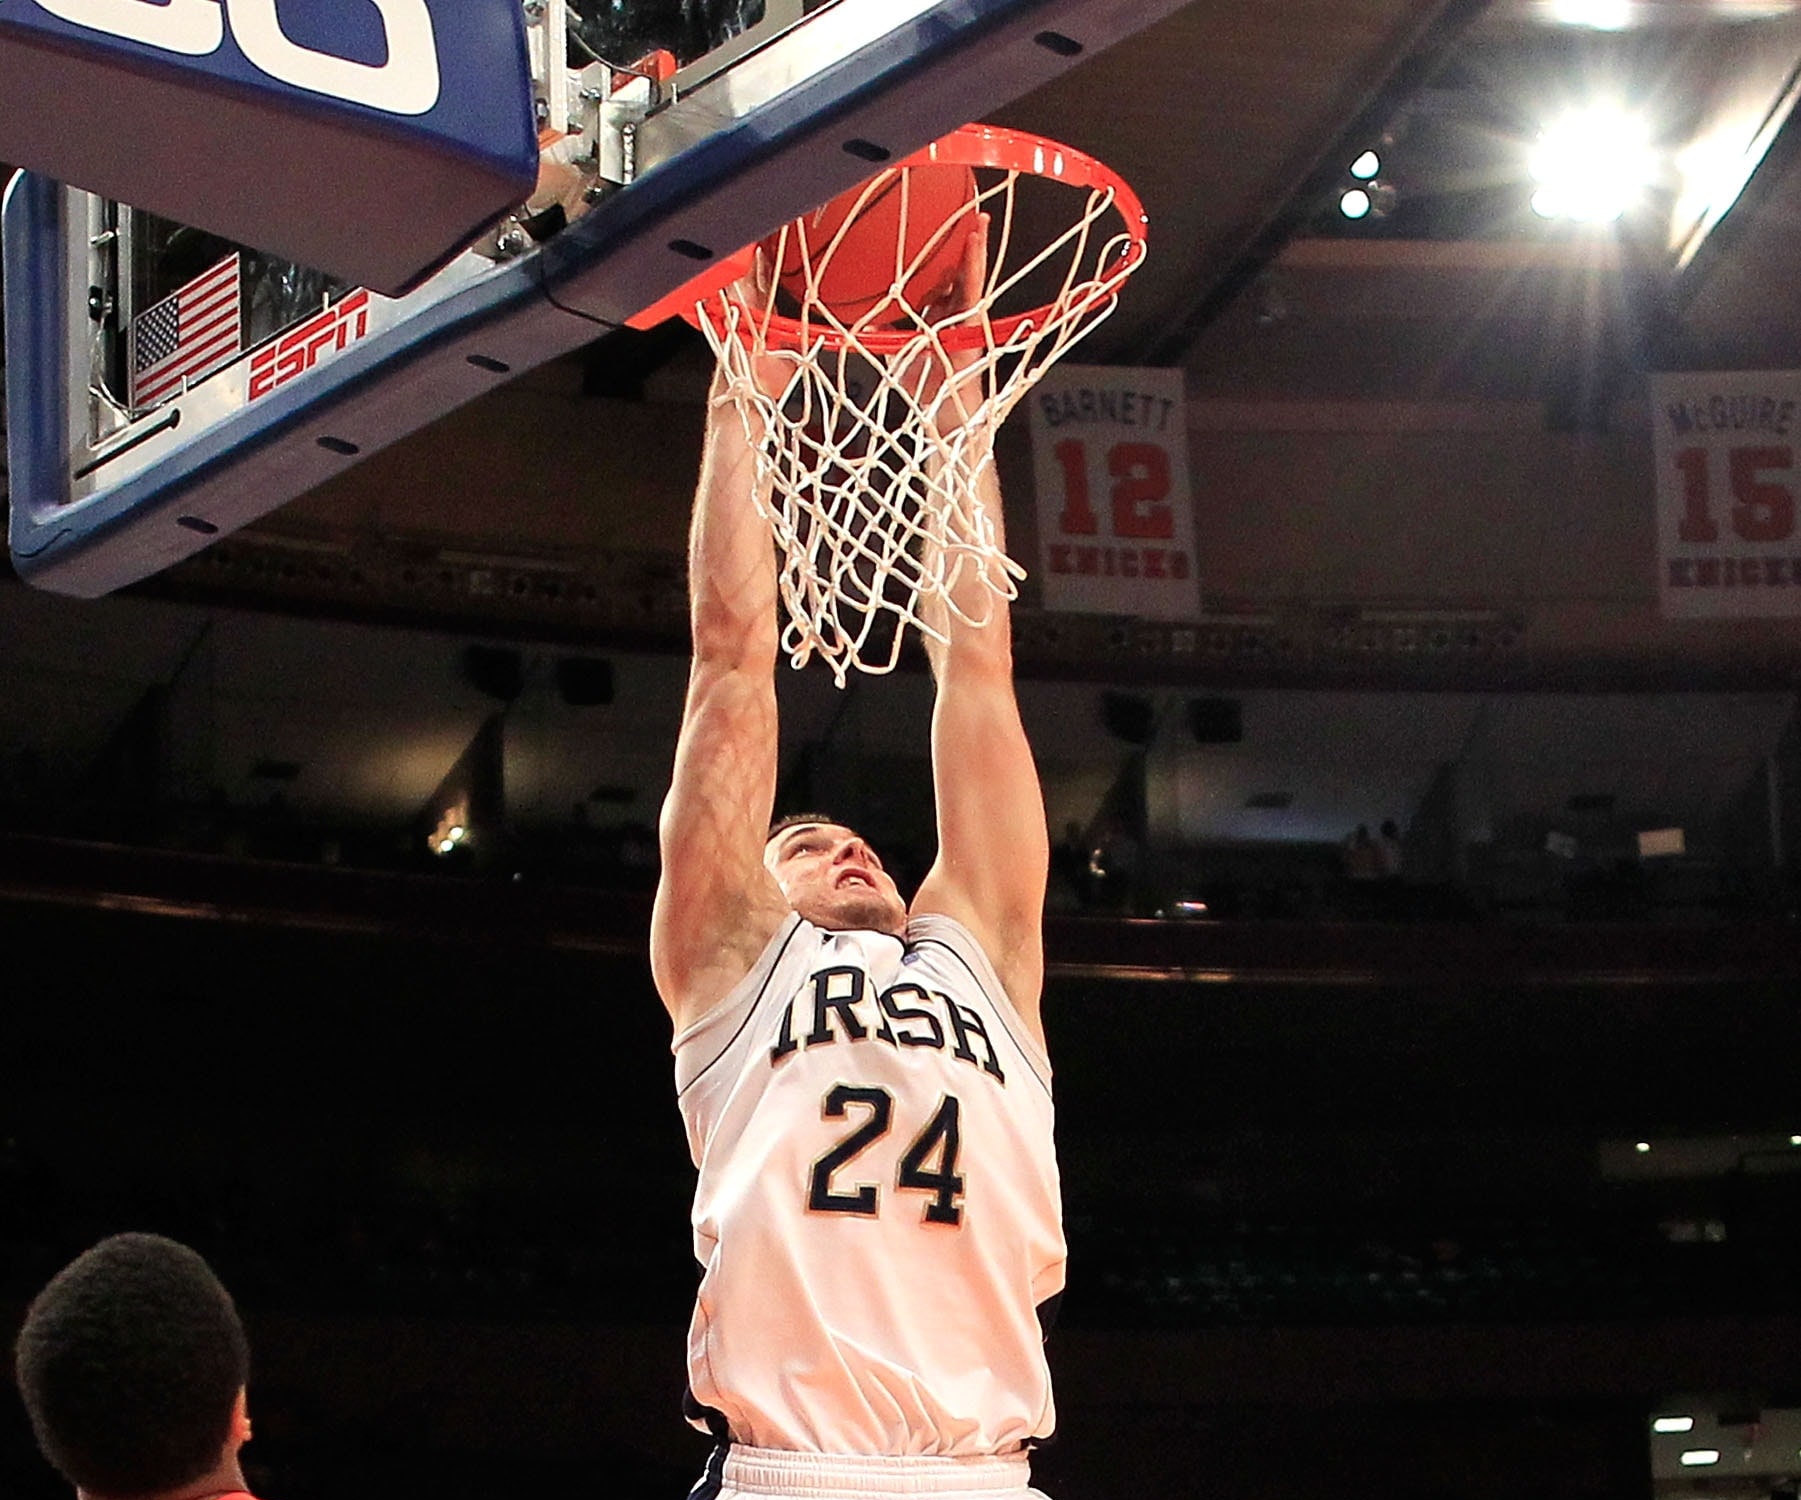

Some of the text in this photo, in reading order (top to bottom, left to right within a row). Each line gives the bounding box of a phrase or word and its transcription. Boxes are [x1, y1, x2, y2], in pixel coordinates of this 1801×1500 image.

[248, 290, 369, 402] ESPN
[1041, 389, 1172, 430] BARNETT
[1053, 437, 1175, 539] 12
[1673, 446, 1794, 542] 15
[1049, 544, 1190, 579] KNICKS
[805, 1081, 966, 1229] 24
